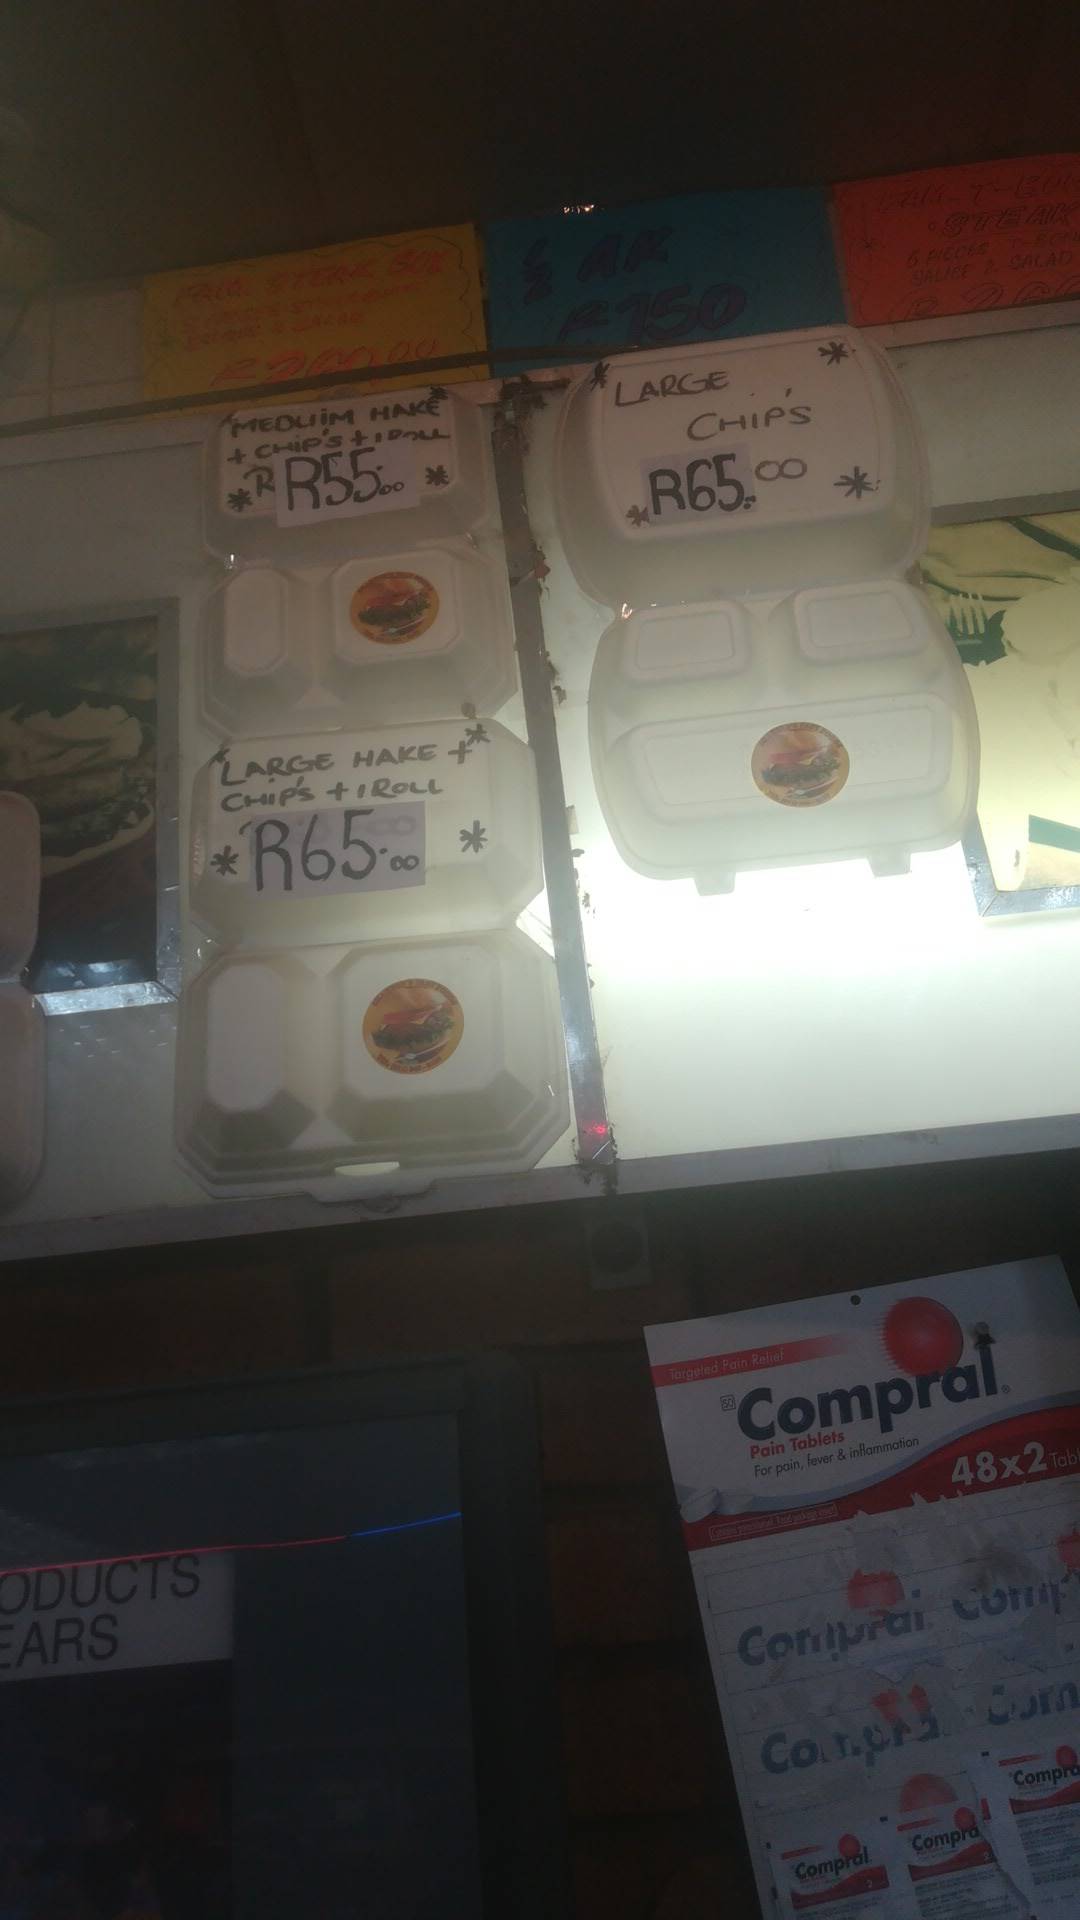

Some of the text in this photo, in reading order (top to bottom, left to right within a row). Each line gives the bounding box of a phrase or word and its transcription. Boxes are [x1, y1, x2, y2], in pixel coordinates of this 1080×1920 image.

[614, 371, 729, 407] LARGE
[370, 400, 440, 421] HAKE
[220, 754, 335, 786] LARGE
[353, 745, 438, 768] HAKE
[371, 779, 447, 798] ROLL
[669, 1348, 785, 1382] Targeted Pain Relief
[737, 1338, 999, 1441] Compral
[750, 1431, 846, 1460] Pain Tablets
[754, 1435, 920, 1479] For pain, fever & inflammation
[951, 1440, 1050, 1487] 48x2
[794, 1846, 869, 1880] Compral
